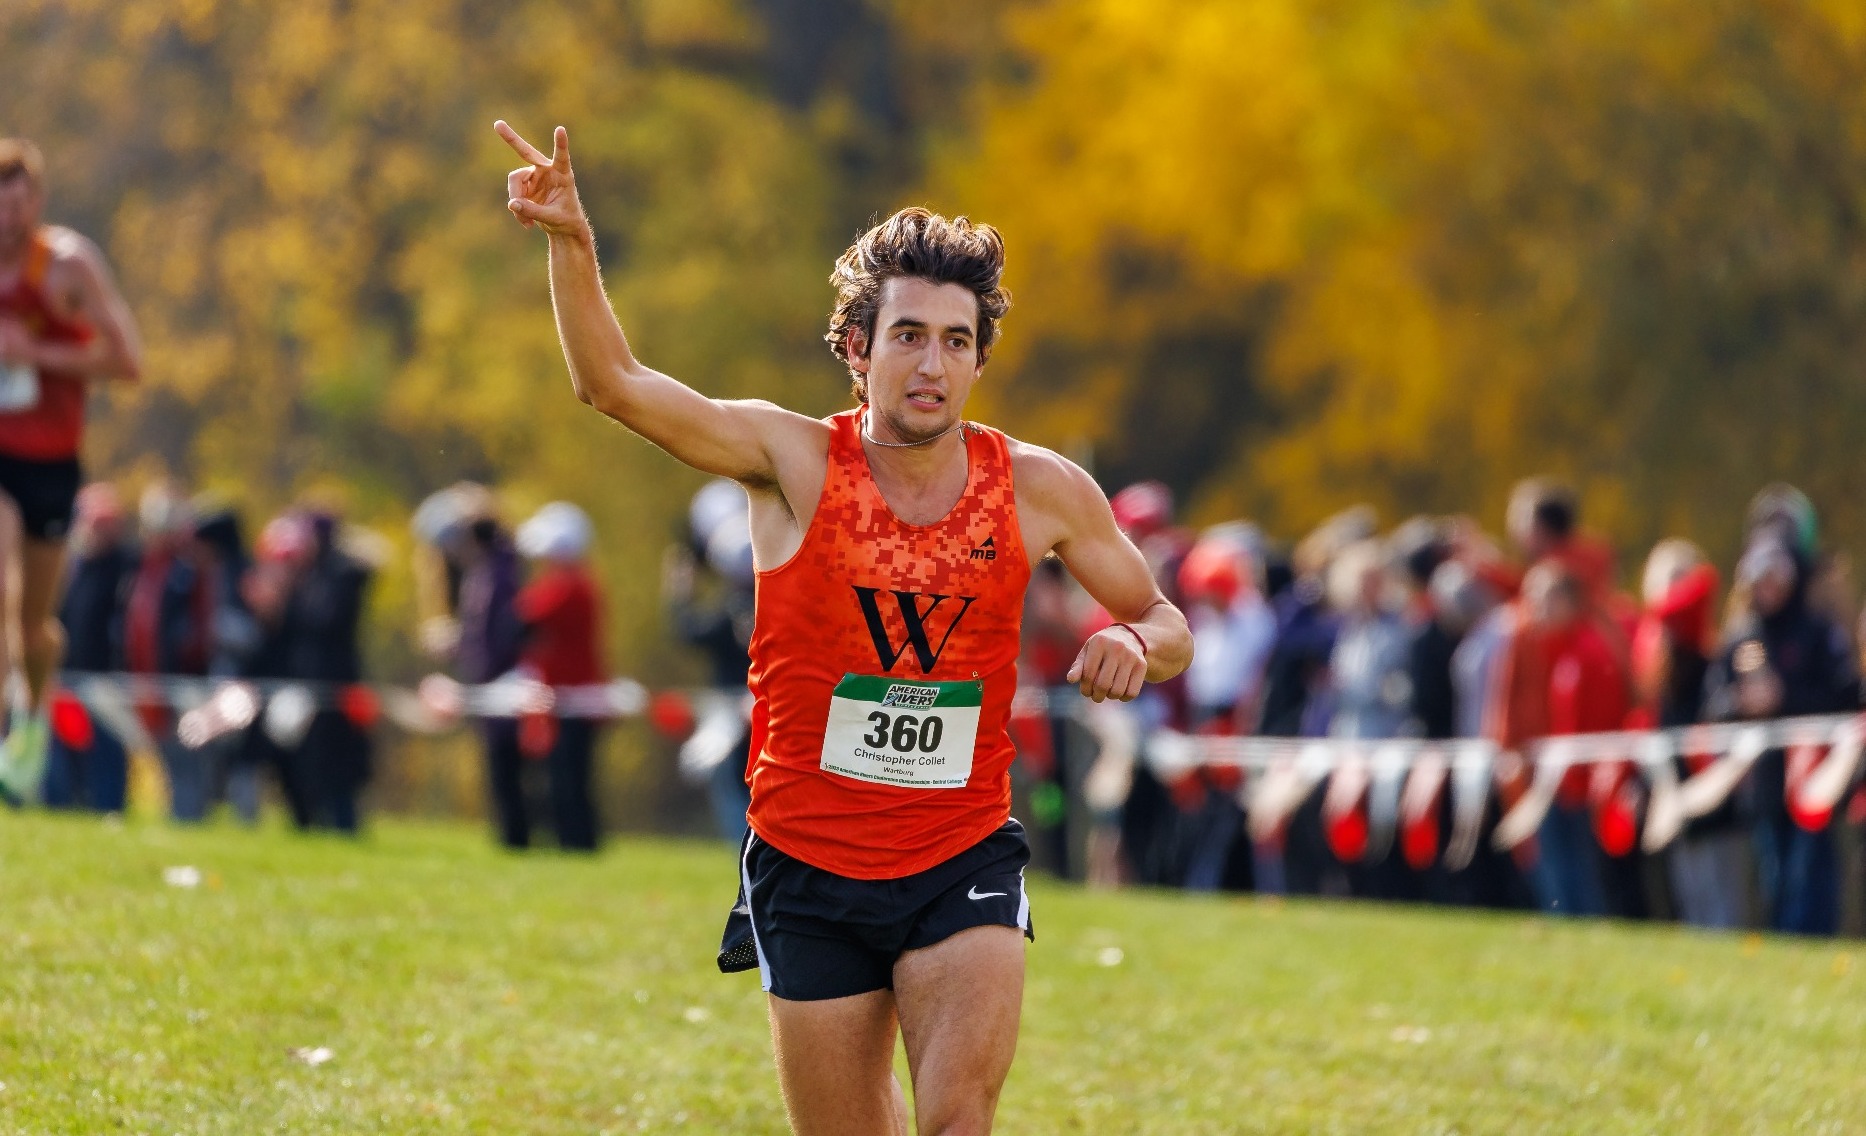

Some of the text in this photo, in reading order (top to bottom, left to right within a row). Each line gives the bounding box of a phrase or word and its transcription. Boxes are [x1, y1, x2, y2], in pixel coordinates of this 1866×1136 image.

[970, 549, 996, 560] MB
[851, 585, 977, 674] W
[889, 686, 938, 696] AMERICAN
[863, 710, 943, 753] 360
[854, 748, 946, 766] Christopher Collet
[883, 766, 914, 777] Wartburg
